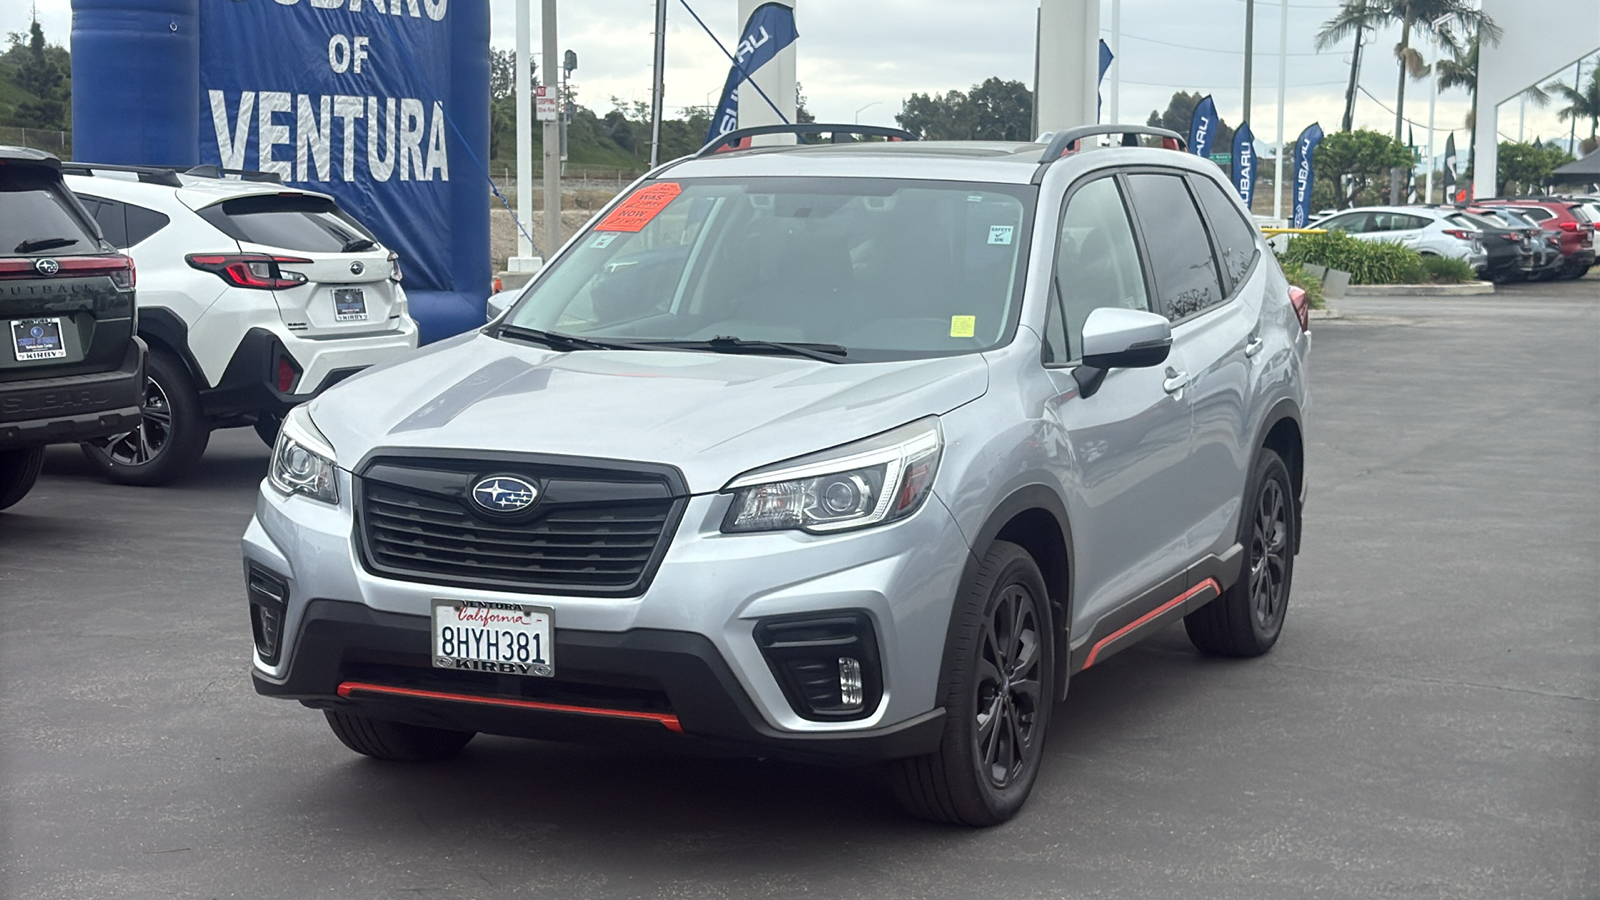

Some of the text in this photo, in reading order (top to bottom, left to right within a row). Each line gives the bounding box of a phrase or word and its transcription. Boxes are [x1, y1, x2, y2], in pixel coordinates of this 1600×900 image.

[328, 34, 369, 74] OF
[208, 89, 449, 183] VENTURA
[1240, 142, 1251, 209] UBARU
[26, 351, 57, 359] KIRBY
[457, 605, 532, 627] California
[461, 600, 523, 611] VENTURA
[442, 625, 546, 665] 8HYH381
[456, 658, 532, 674] KIRBY
